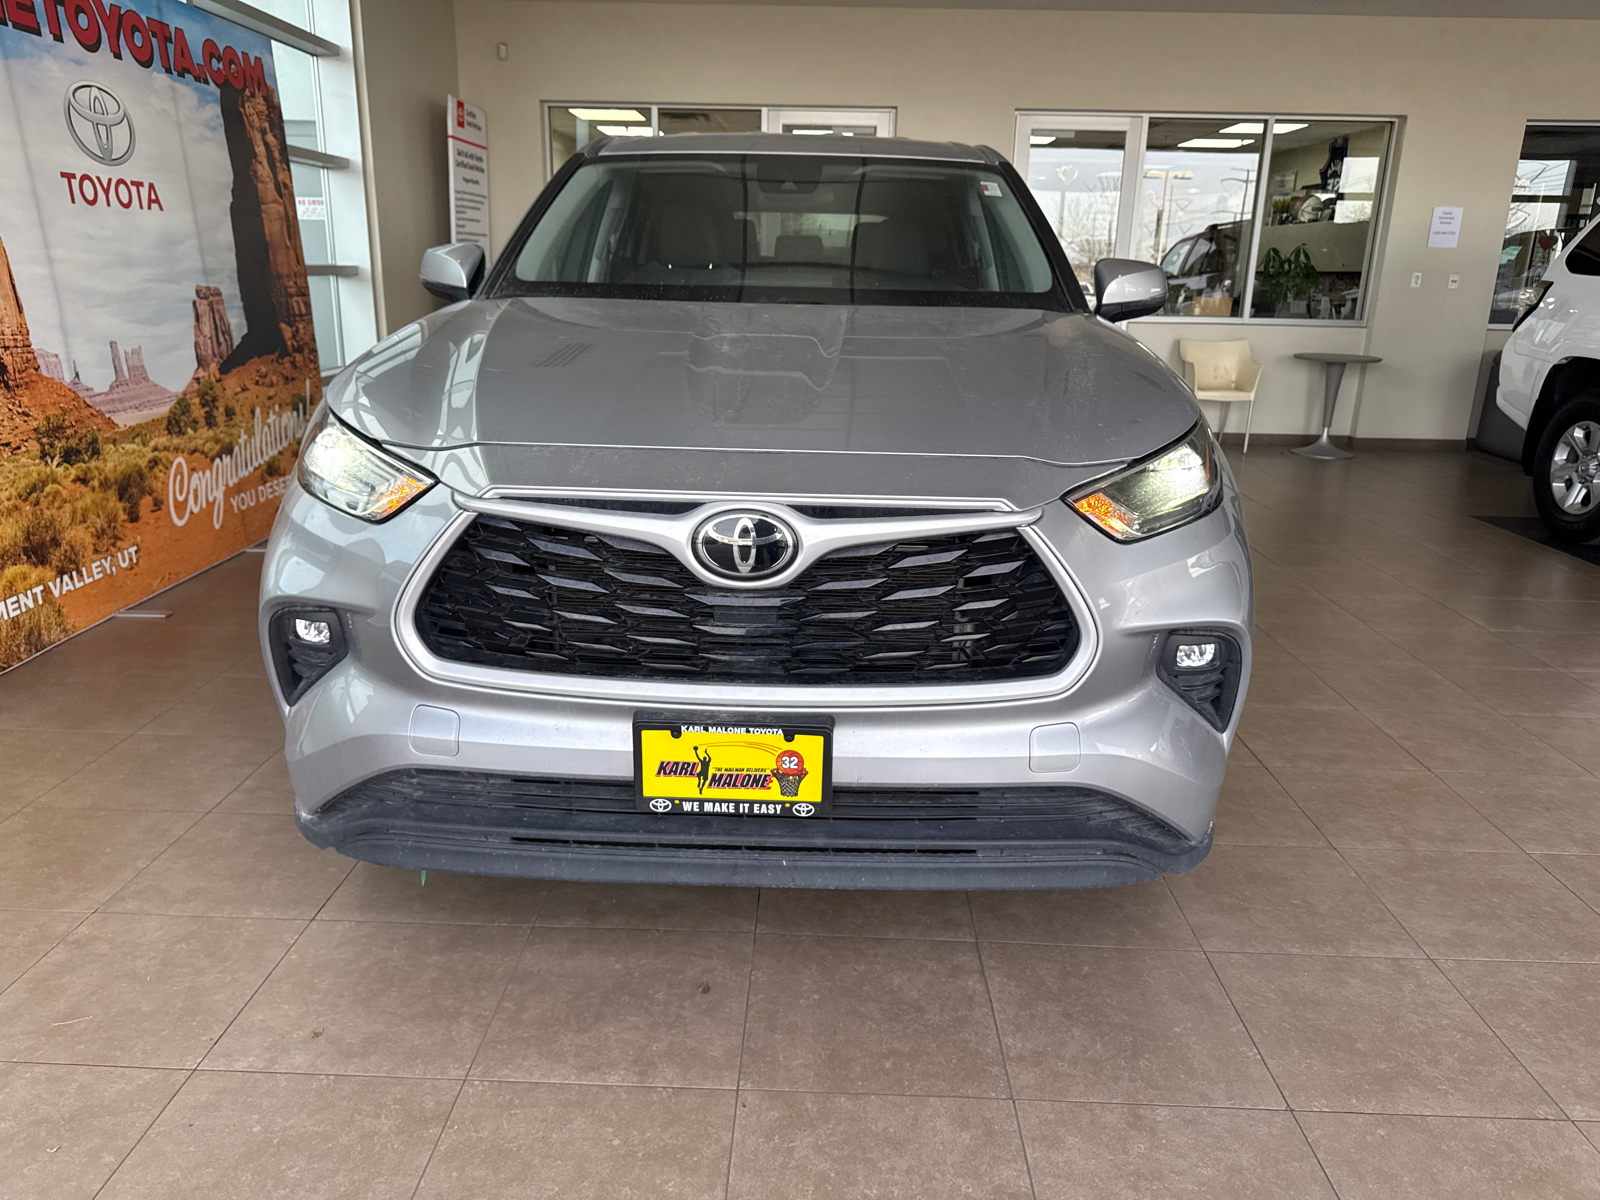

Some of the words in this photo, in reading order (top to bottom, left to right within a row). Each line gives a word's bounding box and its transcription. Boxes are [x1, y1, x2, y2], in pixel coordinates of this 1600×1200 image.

[0, 0, 269, 97] ETOYOTA.COM
[60, 171, 164, 212] TOYOTA
[230, 489, 256, 514] YOU
[48, 555, 117, 598] VALLEY,
[117, 545, 138, 569] UT
[680, 725, 706, 733] KARL
[708, 726, 747, 734] MALONE
[655, 760, 700, 777] KARL
[781, 756, 798, 769] 32
[707, 772, 773, 790] MALONE
[682, 801, 700, 812] WE
[703, 802, 735, 813] MAKE
[739, 803, 750, 814] IT
[753, 803, 782, 814] EASY
